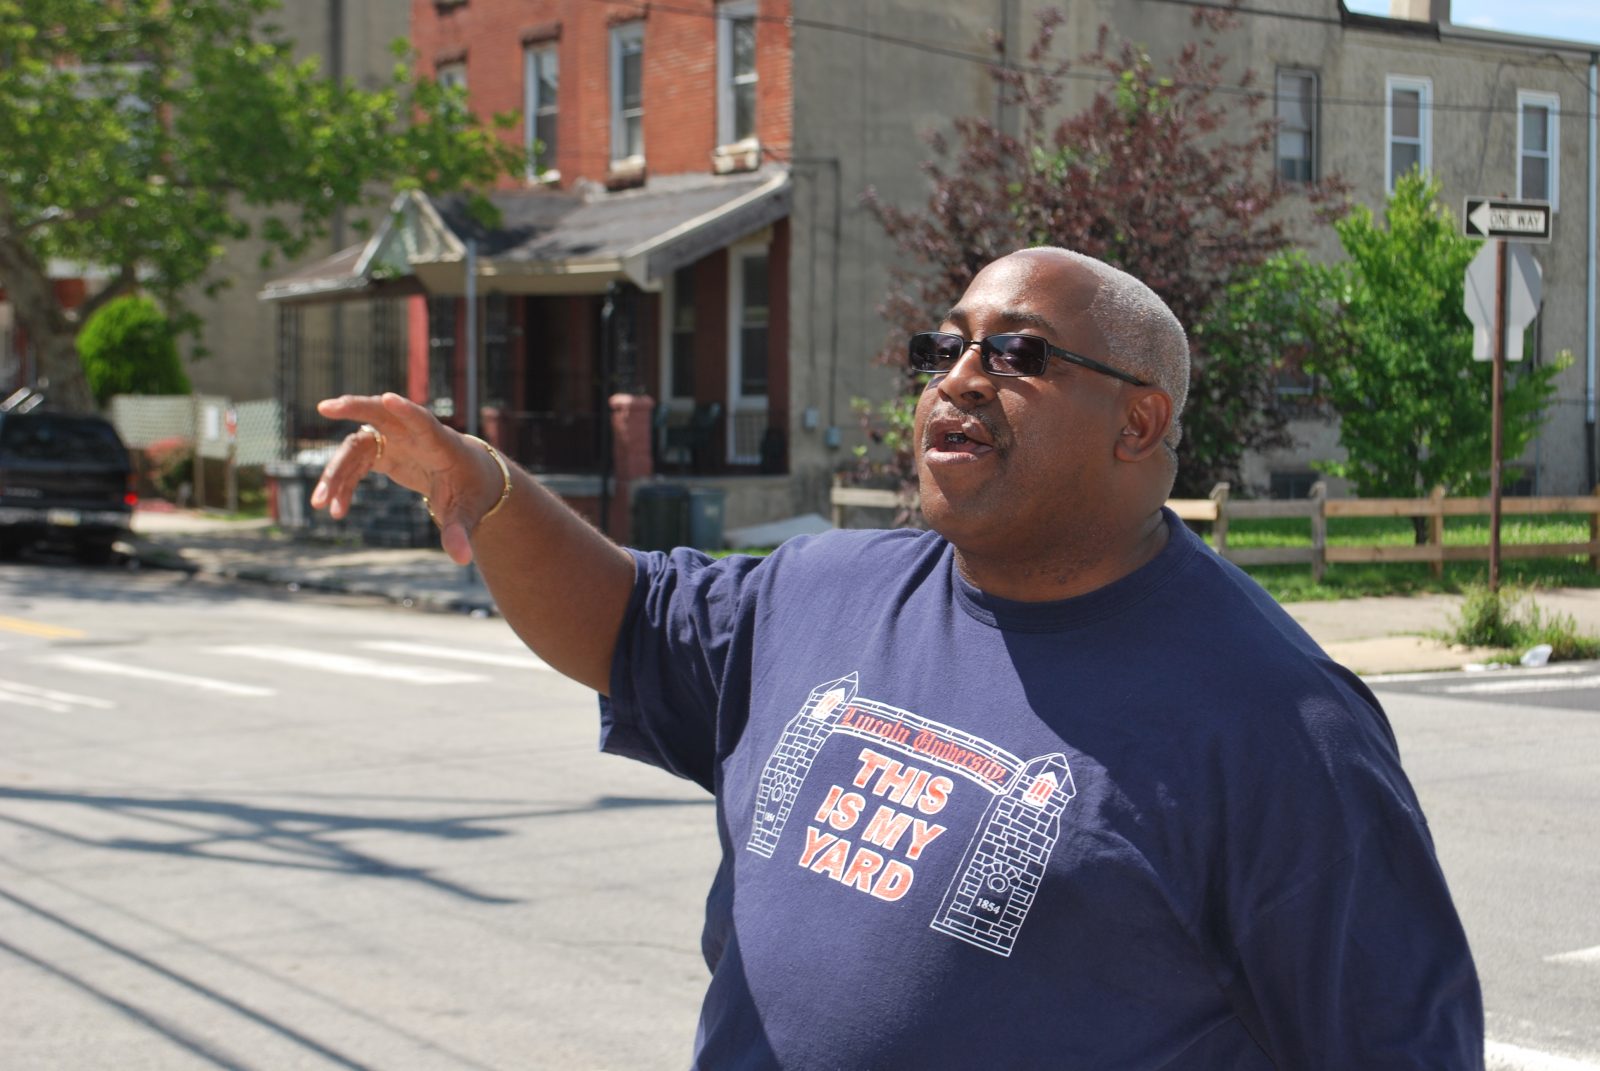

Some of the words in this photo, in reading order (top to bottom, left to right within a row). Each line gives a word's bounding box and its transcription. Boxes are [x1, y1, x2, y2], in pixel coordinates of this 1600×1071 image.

[1490, 211, 1512, 229] ONE
[1517, 213, 1540, 230] WAY
[841, 706, 911, 744] Lincoln
[853, 748, 953, 815] THIS
[814, 785, 866, 831] IS
[861, 805, 948, 860] MY
[798, 826, 914, 902] YARD
[976, 897, 1001, 915] 1854
